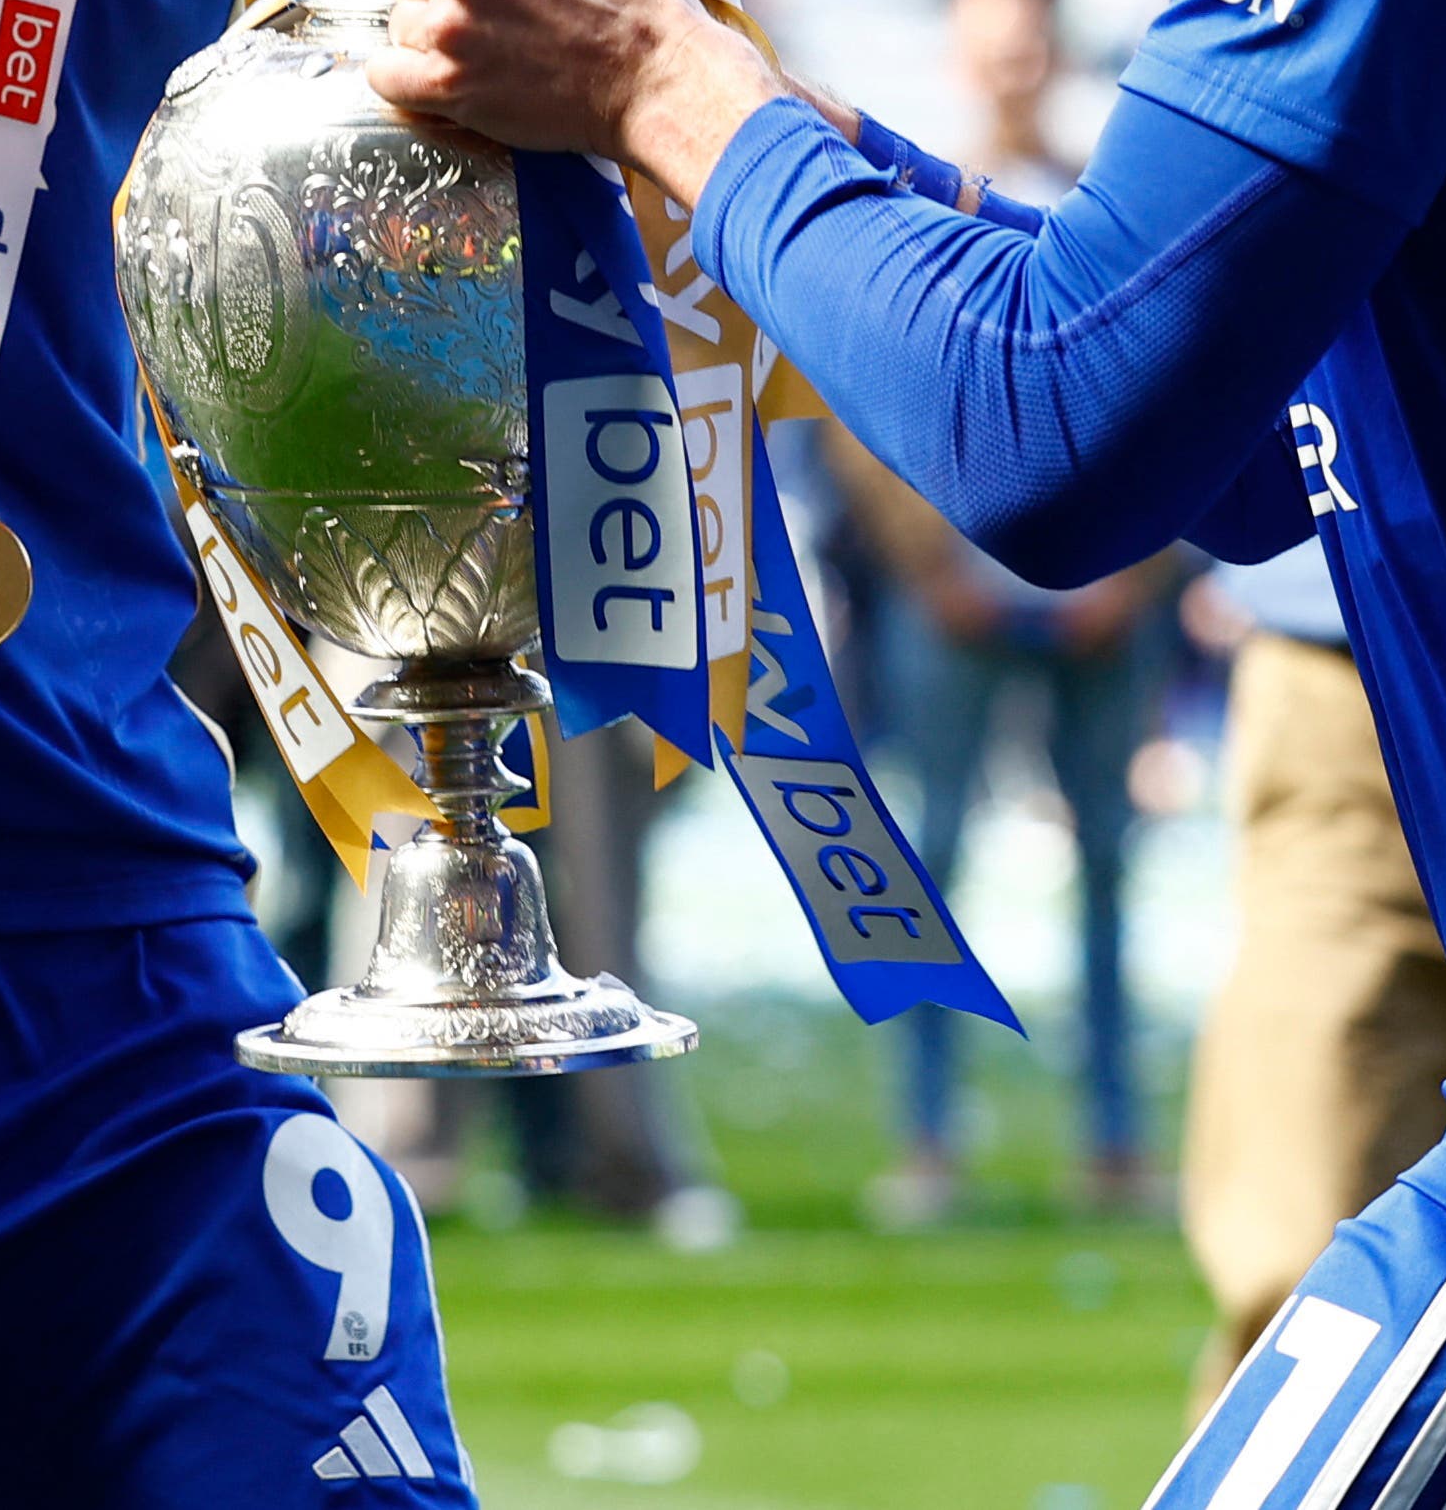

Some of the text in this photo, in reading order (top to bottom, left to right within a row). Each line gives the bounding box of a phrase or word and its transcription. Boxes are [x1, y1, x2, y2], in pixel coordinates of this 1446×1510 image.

[1, 11, 53, 109] bet
[584, 409, 675, 632] bet
[201, 535, 321, 746] bet
[772, 780, 922, 939] bet
[263, 1113, 395, 1361] 9
